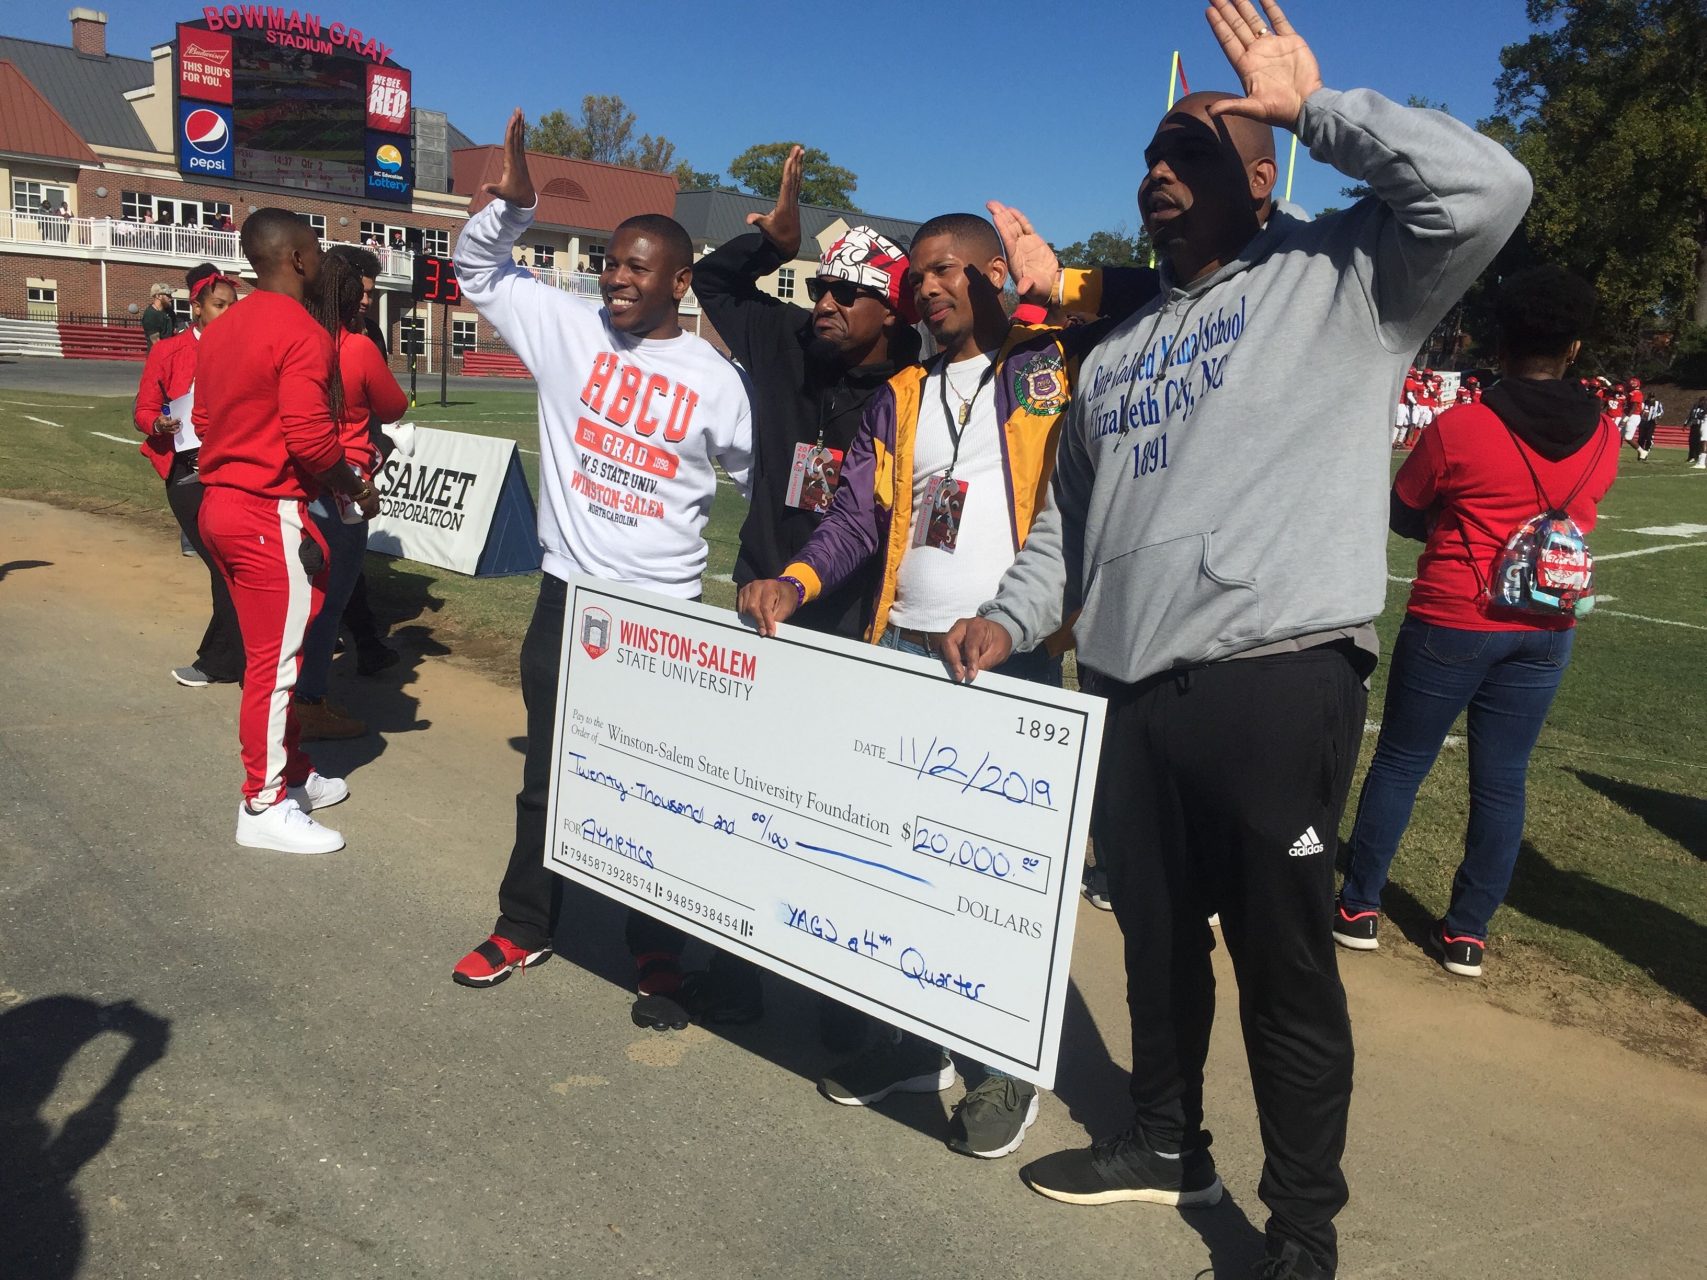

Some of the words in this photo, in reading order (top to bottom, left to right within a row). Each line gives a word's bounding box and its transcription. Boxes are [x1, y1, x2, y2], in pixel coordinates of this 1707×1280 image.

[203, 4, 320, 38] BOWMAN
[329, 21, 394, 65] GRAY
[266, 30, 333, 55] STADIUM
[182, 60, 203, 73] THIS
[204, 64, 230, 78] BUD'S
[188, 46, 226, 61] Budweiser
[183, 71, 200, 83] FOR
[202, 75, 222, 87] YOU.
[373, 74, 386, 86] WE
[386, 77, 402, 89] SEE
[369, 84, 408, 119] RED
[189, 157, 226, 170] pepsi
[373, 170, 382, 178] NC
[368, 175, 408, 193] Lottery
[579, 351, 700, 443] HBCU
[582, 428, 596, 445] EST.
[602, 433, 648, 468] GRAD
[1133, 432, 1168, 479] 1891
[380, 460, 478, 511] SAMET
[581, 453, 599, 475] W.S.
[600, 462, 629, 486] STATE
[631, 475, 658, 495] UNIV.
[570, 469, 665, 520] WINSTON-SALEM
[587, 502, 607, 519] NORTH
[606, 509, 638, 528] CAROLINA
[620, 619, 757, 681] WINSTON-SALEM
[616, 647, 656, 673] STATE
[662, 660, 754, 701] UNIVERSITY
[571, 723, 591, 739] Order
[591, 732, 600, 745] of
[572, 708, 585, 724] Pay
[585, 715, 593, 724] to
[593, 716, 604, 729] the
[1015, 716, 1071, 747] 1892
[853, 739, 886, 760] DATE
[608, 723, 694, 768] Winston-Salem
[698, 755, 730, 781] State
[734, 766, 803, 809] University
[806, 791, 890, 836] Foundation
[900, 735, 1051, 806] 11/2/2019
[563, 817, 581, 836] FOR
[581, 817, 655, 870] Athletics
[1288, 843, 1324, 857] adidas
[956, 895, 1043, 940] DOLLARS
[899, 946, 986, 1000] Quarter
